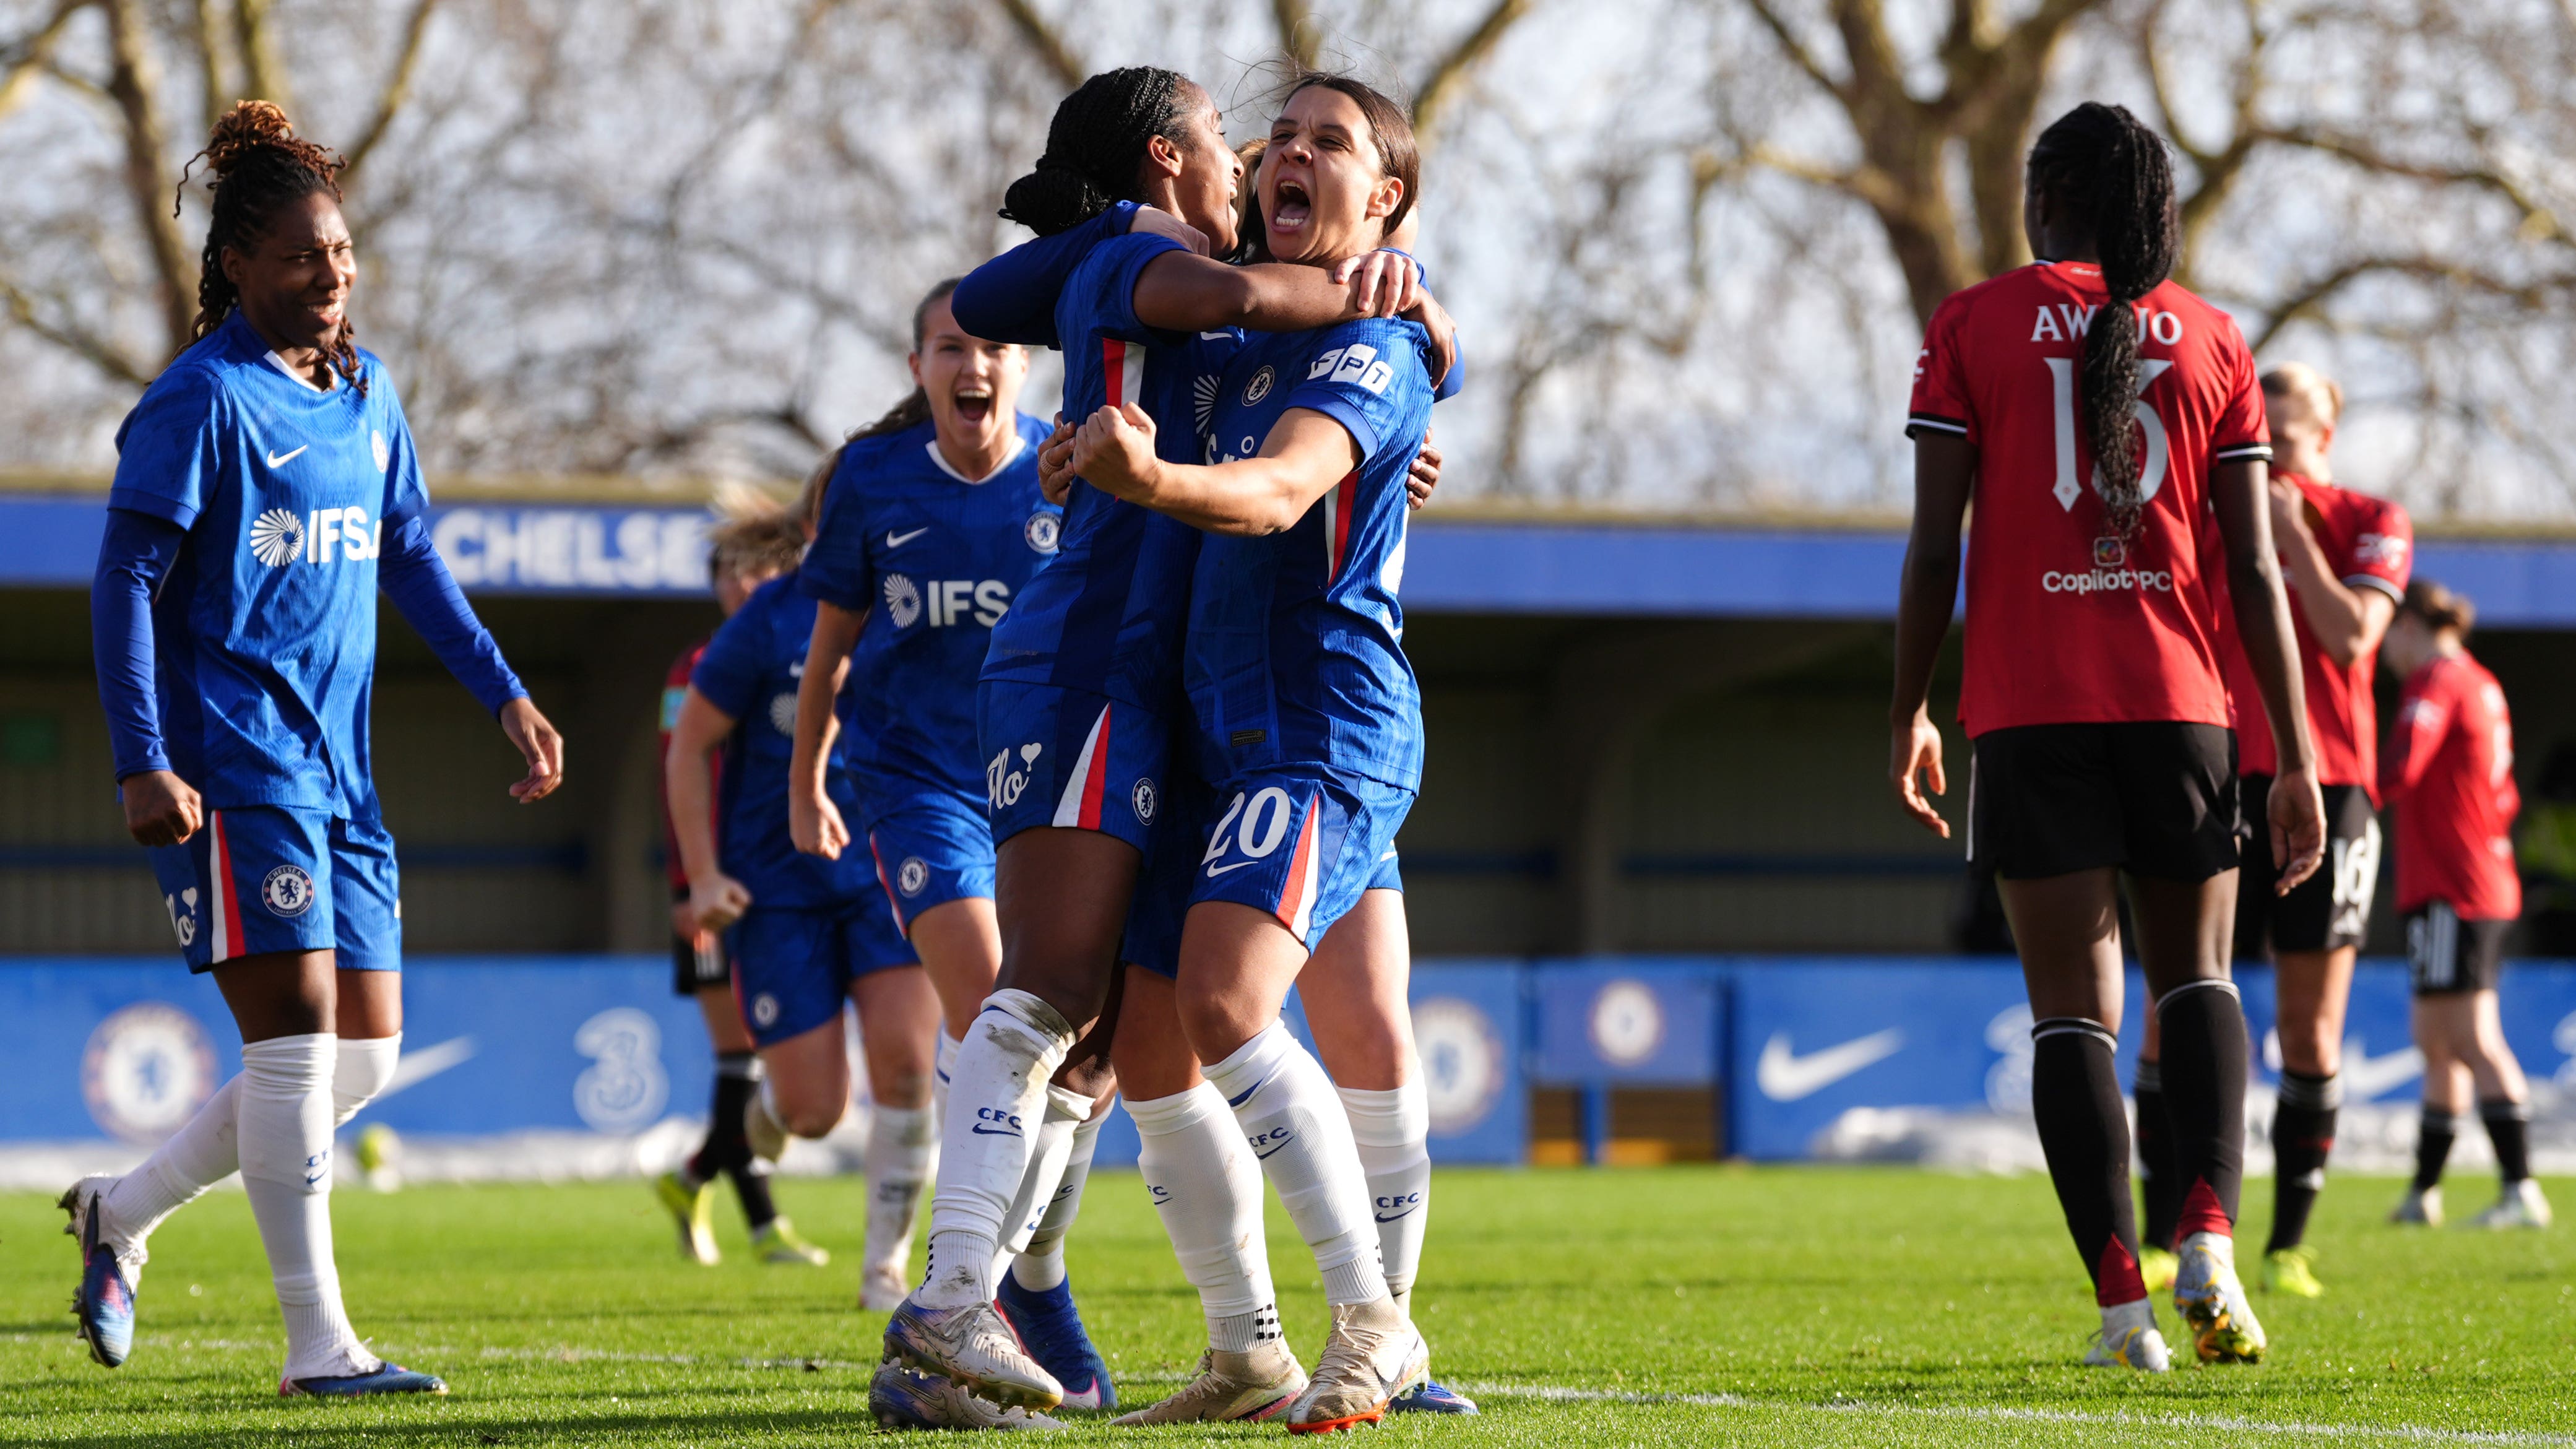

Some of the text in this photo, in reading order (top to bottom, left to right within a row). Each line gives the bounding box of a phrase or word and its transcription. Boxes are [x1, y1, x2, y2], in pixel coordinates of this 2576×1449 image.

[2030, 303, 2183, 345] AWJO
[1312, 352, 1390, 387] FPT
[434, 509, 711, 588] CHELSE
[1201, 787, 1291, 866] 20
[268, 867, 301, 881] CHELSEA
[573, 1006, 670, 1138] 3
[977, 1107, 1022, 1130] CFC
[1248, 1127, 1290, 1148] CFC
[1376, 1192, 1419, 1209] CFC
